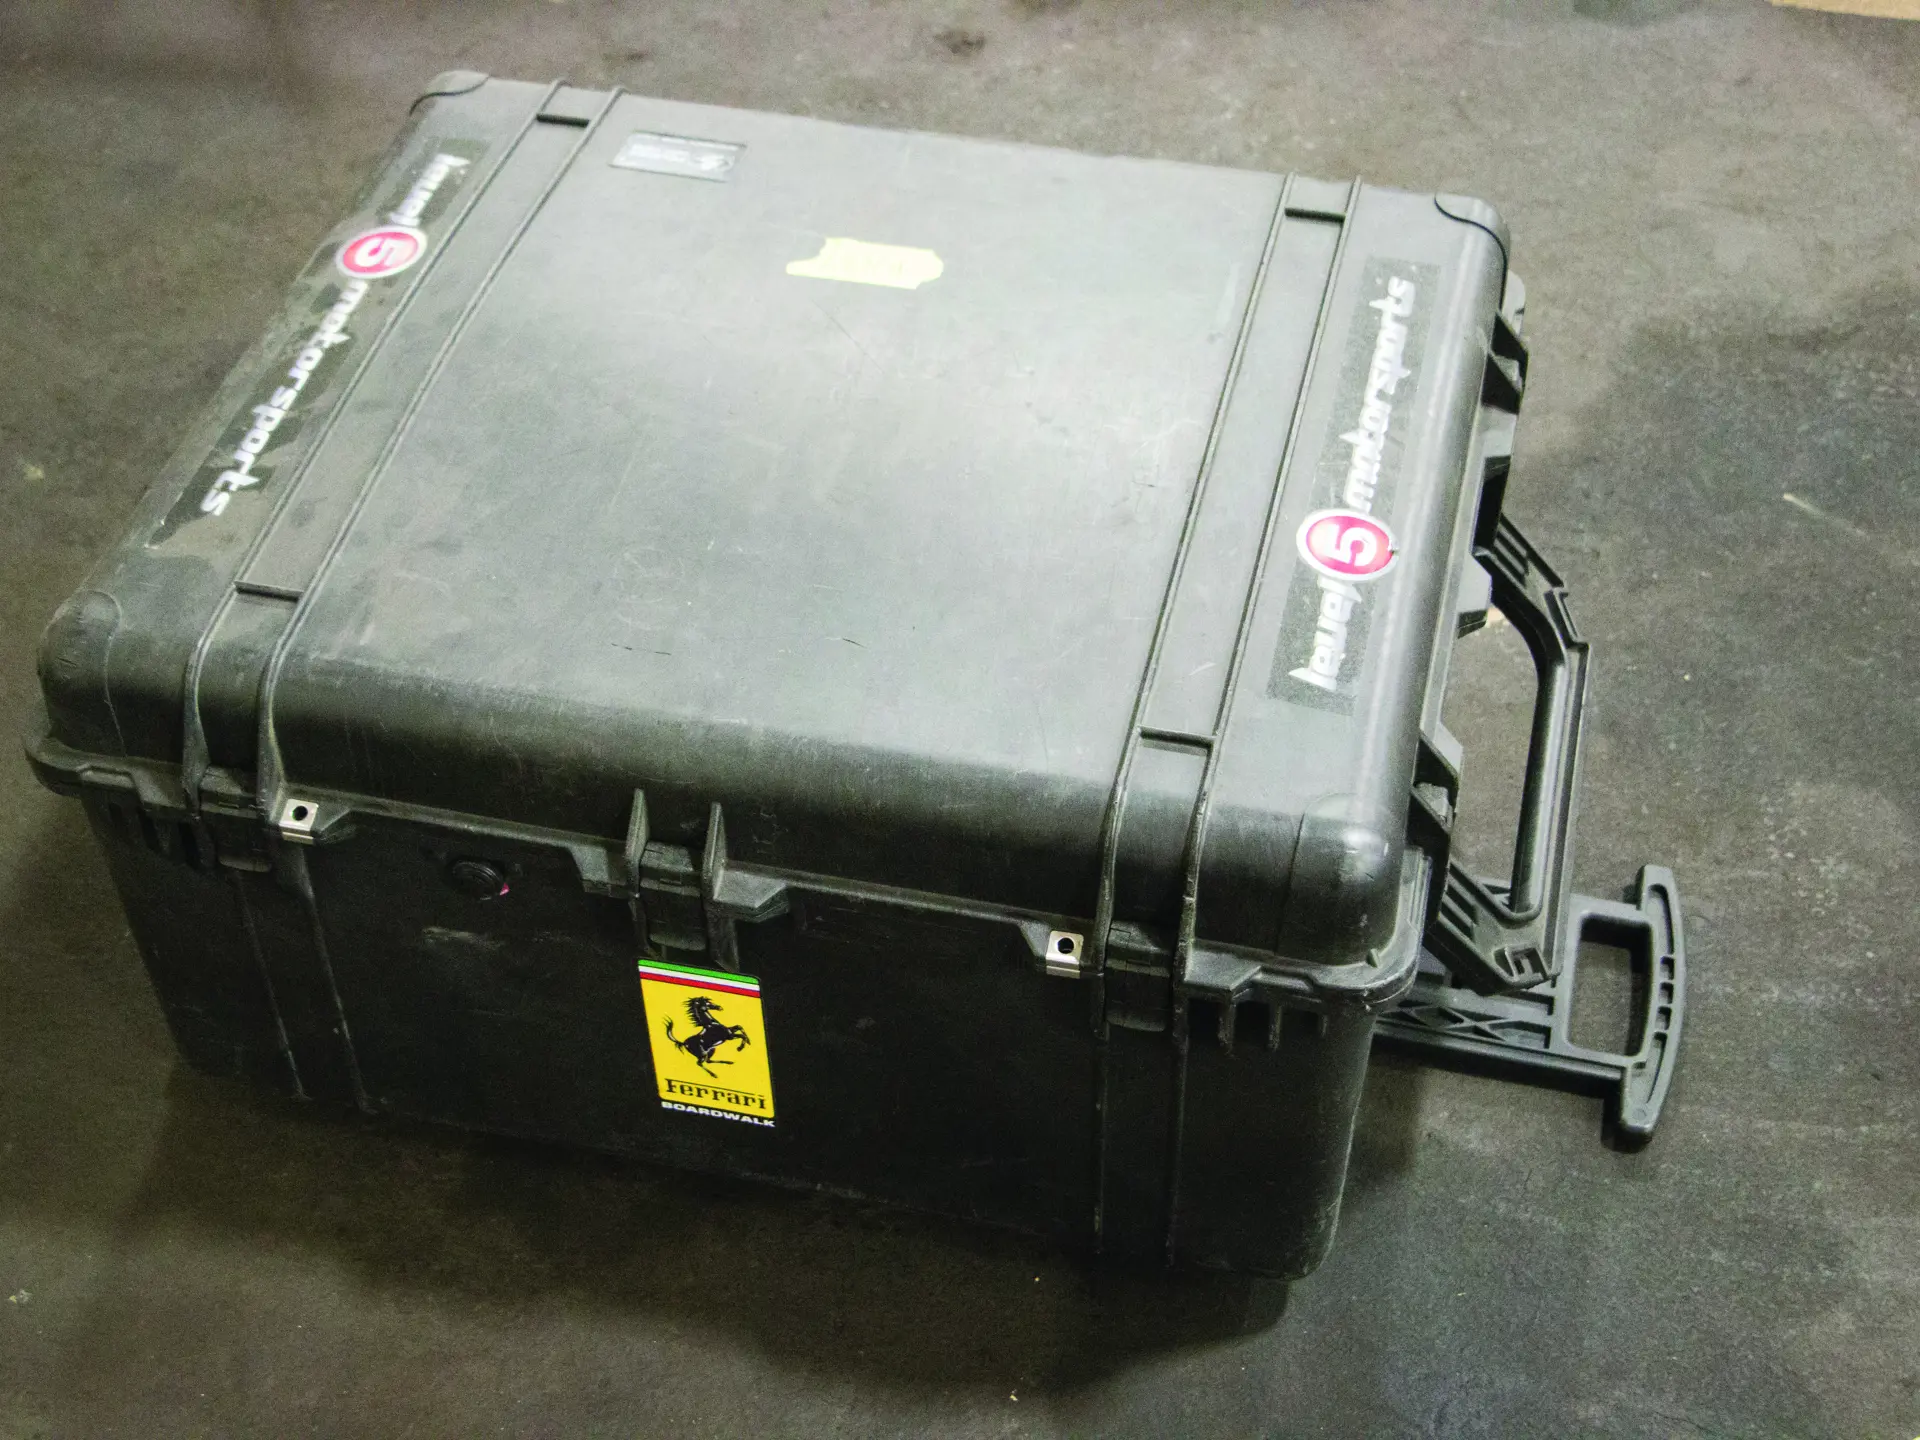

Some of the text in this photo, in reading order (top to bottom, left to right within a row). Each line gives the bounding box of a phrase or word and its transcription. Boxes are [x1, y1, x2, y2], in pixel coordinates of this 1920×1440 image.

[389, 154, 470, 226] level
[202, 280, 368, 515] motorsports
[1288, 575, 1362, 691] level
[1340, 276, 1416, 512] motorsports
[661, 1101, 775, 1127] BOARDWALK
[665, 1079, 766, 1109] Ferrari
